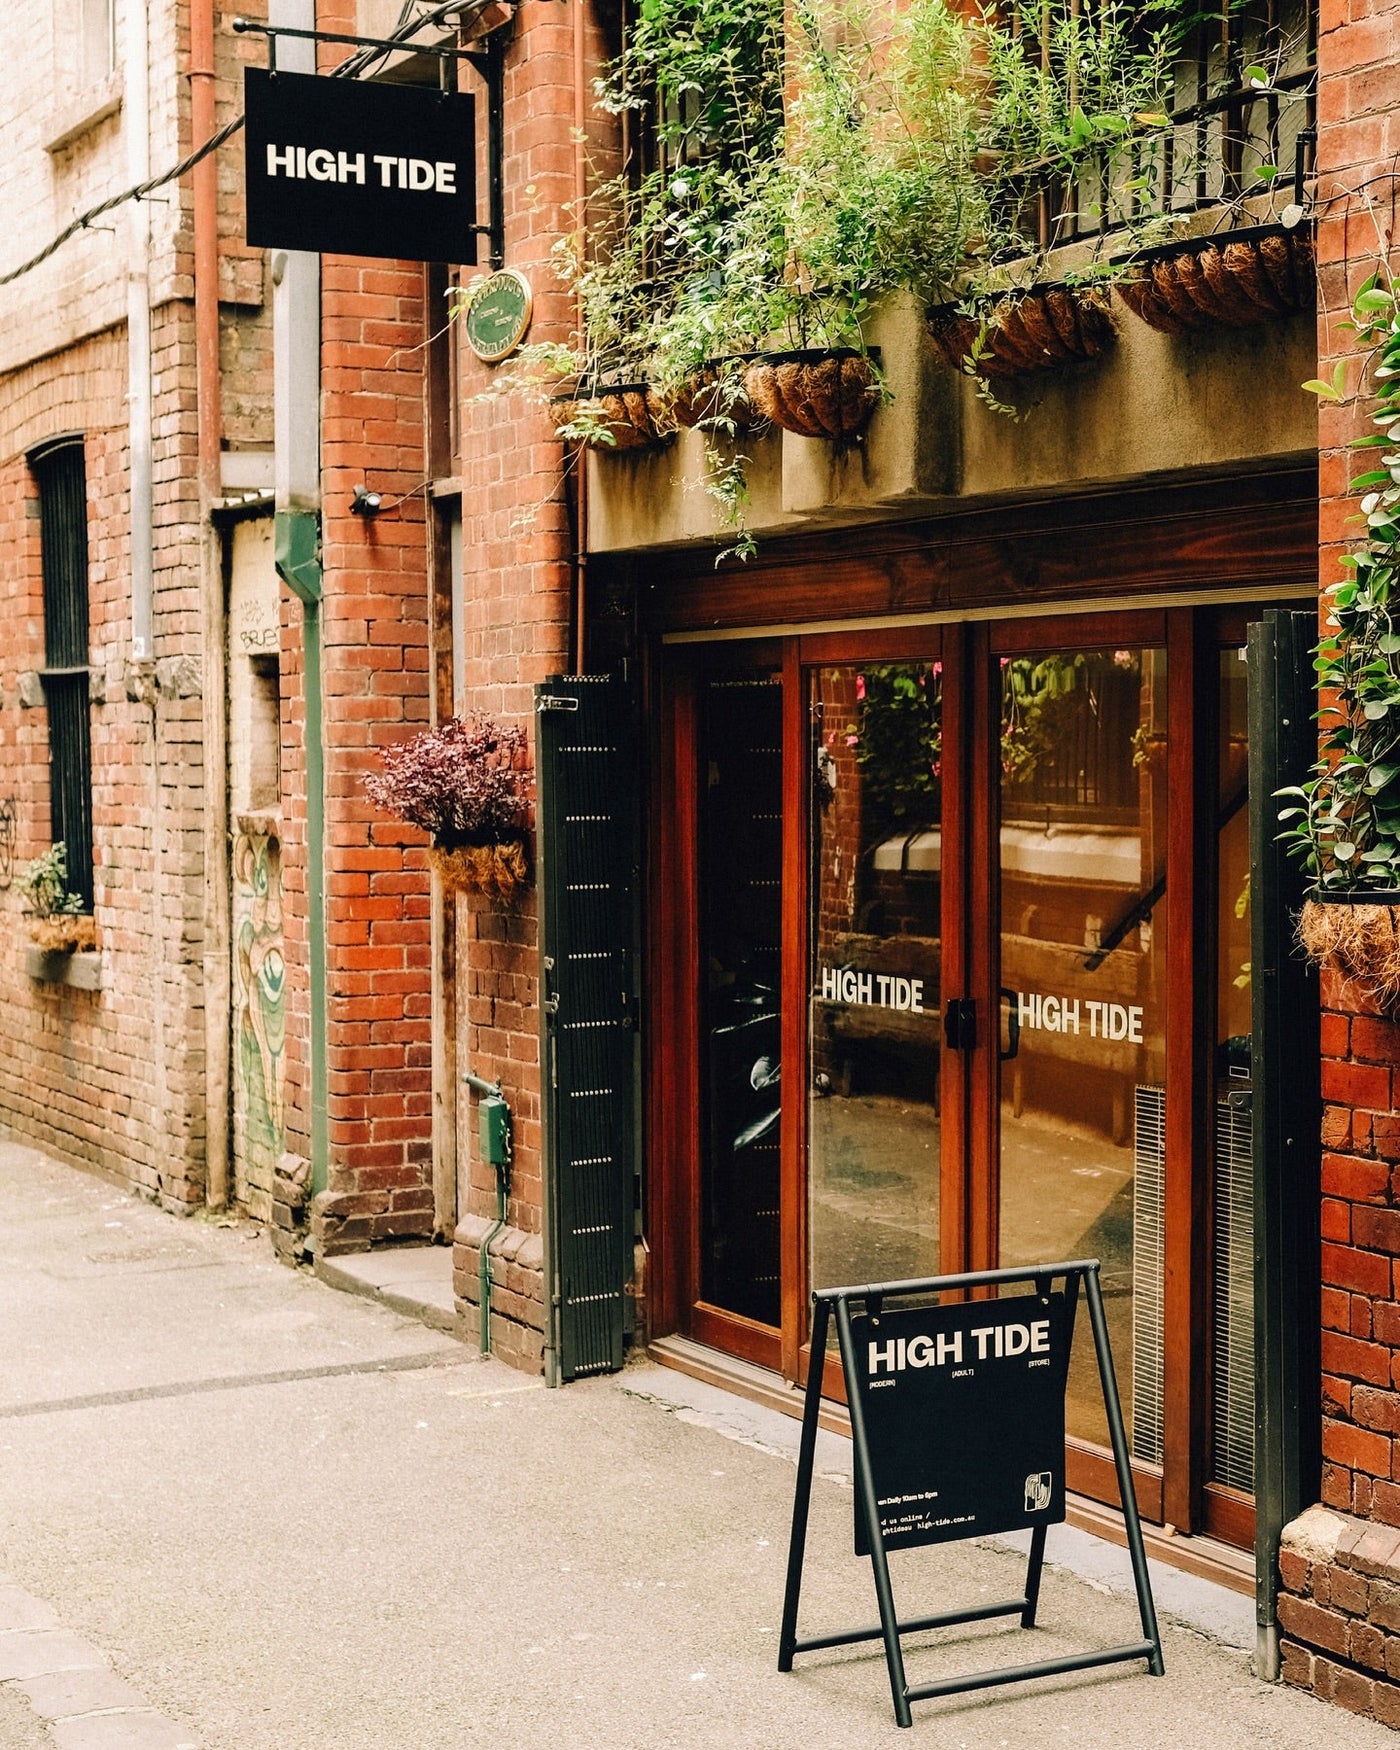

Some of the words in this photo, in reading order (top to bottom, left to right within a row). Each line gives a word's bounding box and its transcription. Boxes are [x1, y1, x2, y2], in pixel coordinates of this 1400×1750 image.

[266, 143, 366, 185] HIGH
[373, 154, 457, 194] TIDE
[822, 967, 872, 1006] HIGH
[876, 974, 924, 1013] TIDE
[1017, 991, 1080, 1036] HIGH
[1085, 1001, 1144, 1044] TIDE
[868, 1330, 963, 1375] HIGH
[970, 1319, 1051, 1360] TIDE
[887, 1496, 902, 1504] Daily
[902, 1494, 918, 1502] 10am
[899, 1514, 923, 1523] online
[917, 1515, 976, 1530] high-tide.com.au
